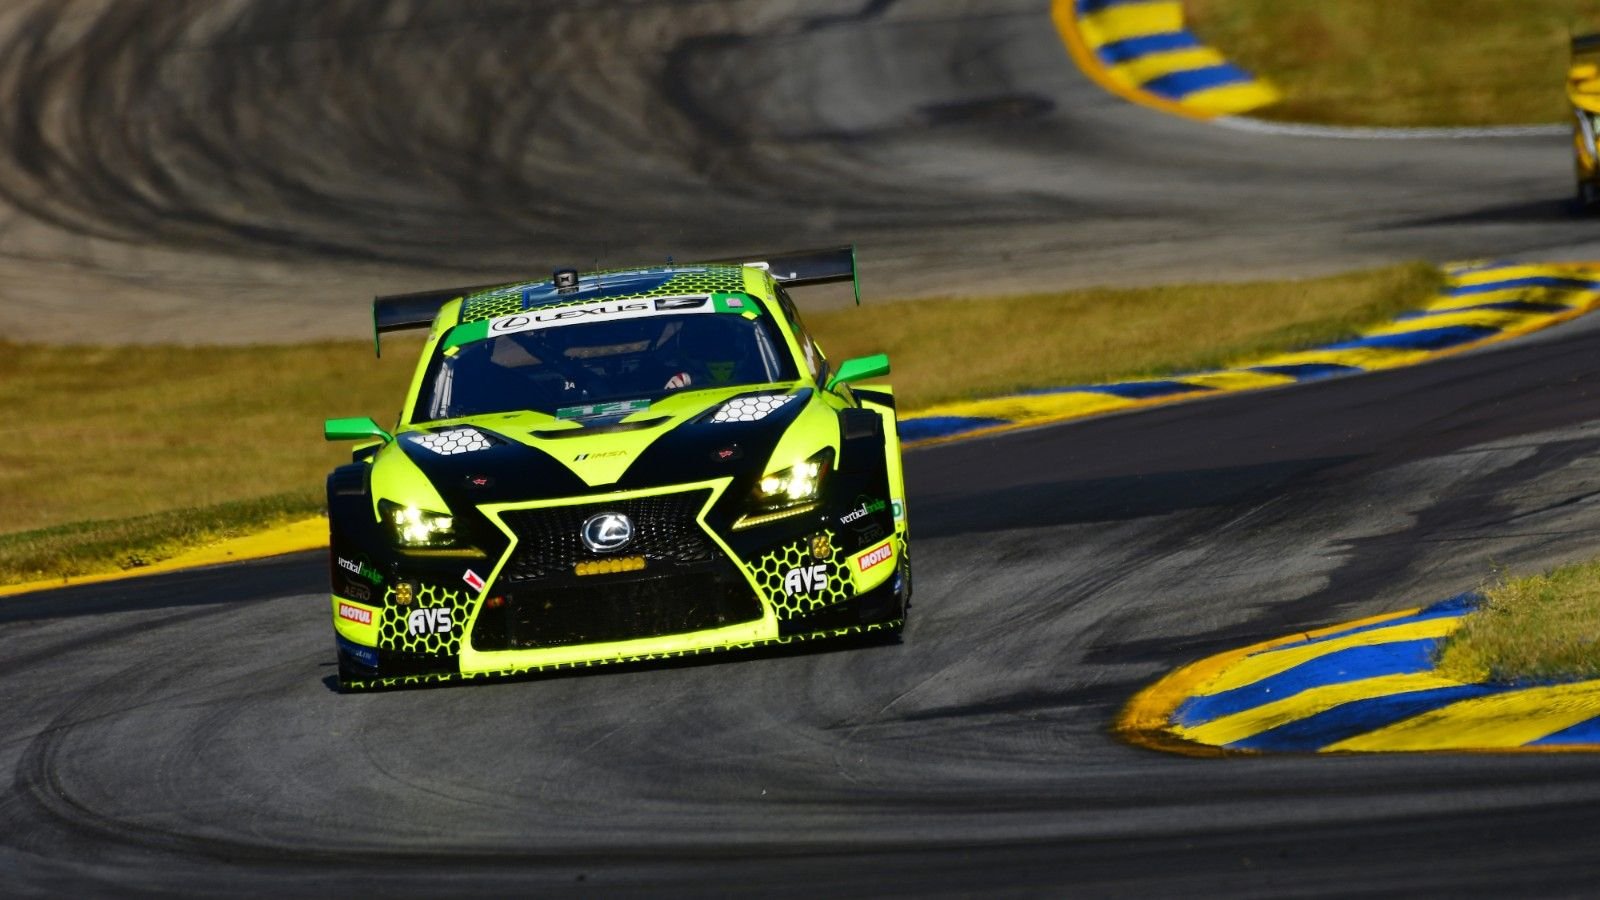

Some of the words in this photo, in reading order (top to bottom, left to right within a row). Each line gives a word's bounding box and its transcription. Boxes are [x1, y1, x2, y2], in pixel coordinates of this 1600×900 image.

[535, 303, 649, 322] LEXUS
[860, 545, 892, 570] MOTUL
[784, 564, 828, 597] AVS
[340, 604, 371, 623] MOTUL
[408, 608, 452, 636] AVS
